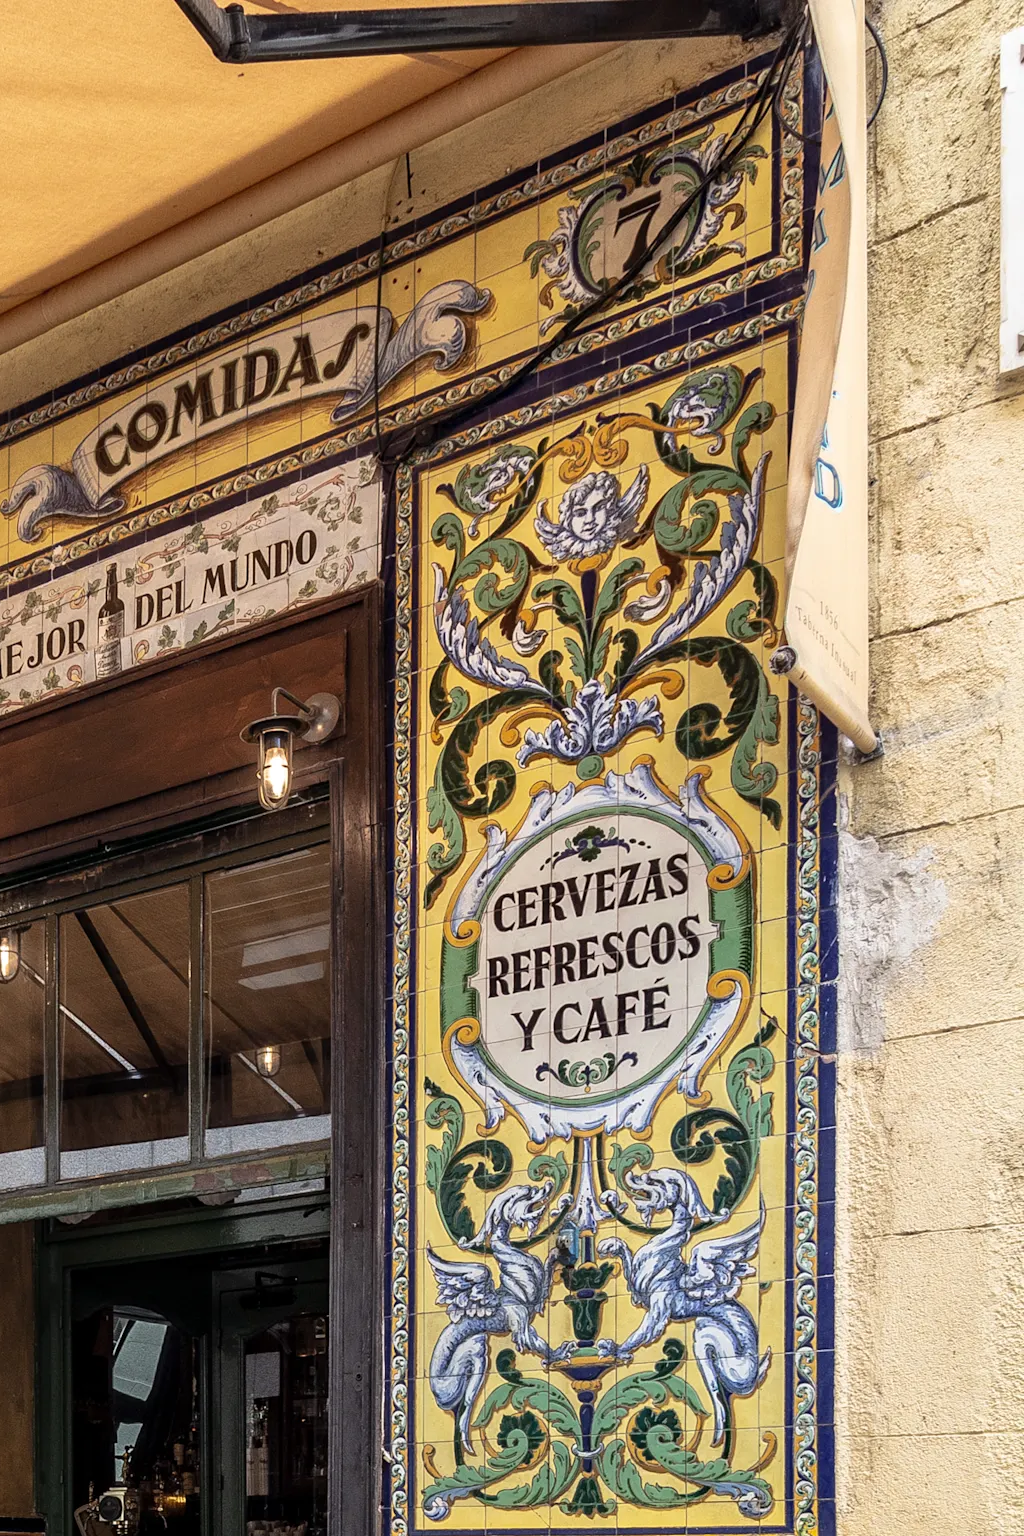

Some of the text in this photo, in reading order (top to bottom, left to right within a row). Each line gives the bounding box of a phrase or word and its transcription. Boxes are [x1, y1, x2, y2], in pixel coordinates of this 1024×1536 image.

[614, 190, 661, 272] 7
[94, 323, 368, 474] COMIDAS
[134, 584, 193, 631] DEL
[202, 528, 317, 605] MUNDO
[493, 853, 688, 931] CERVEZAS
[487, 915, 700, 998] REFRESCOS
[510, 977, 671, 1052] Y CAFÉ
